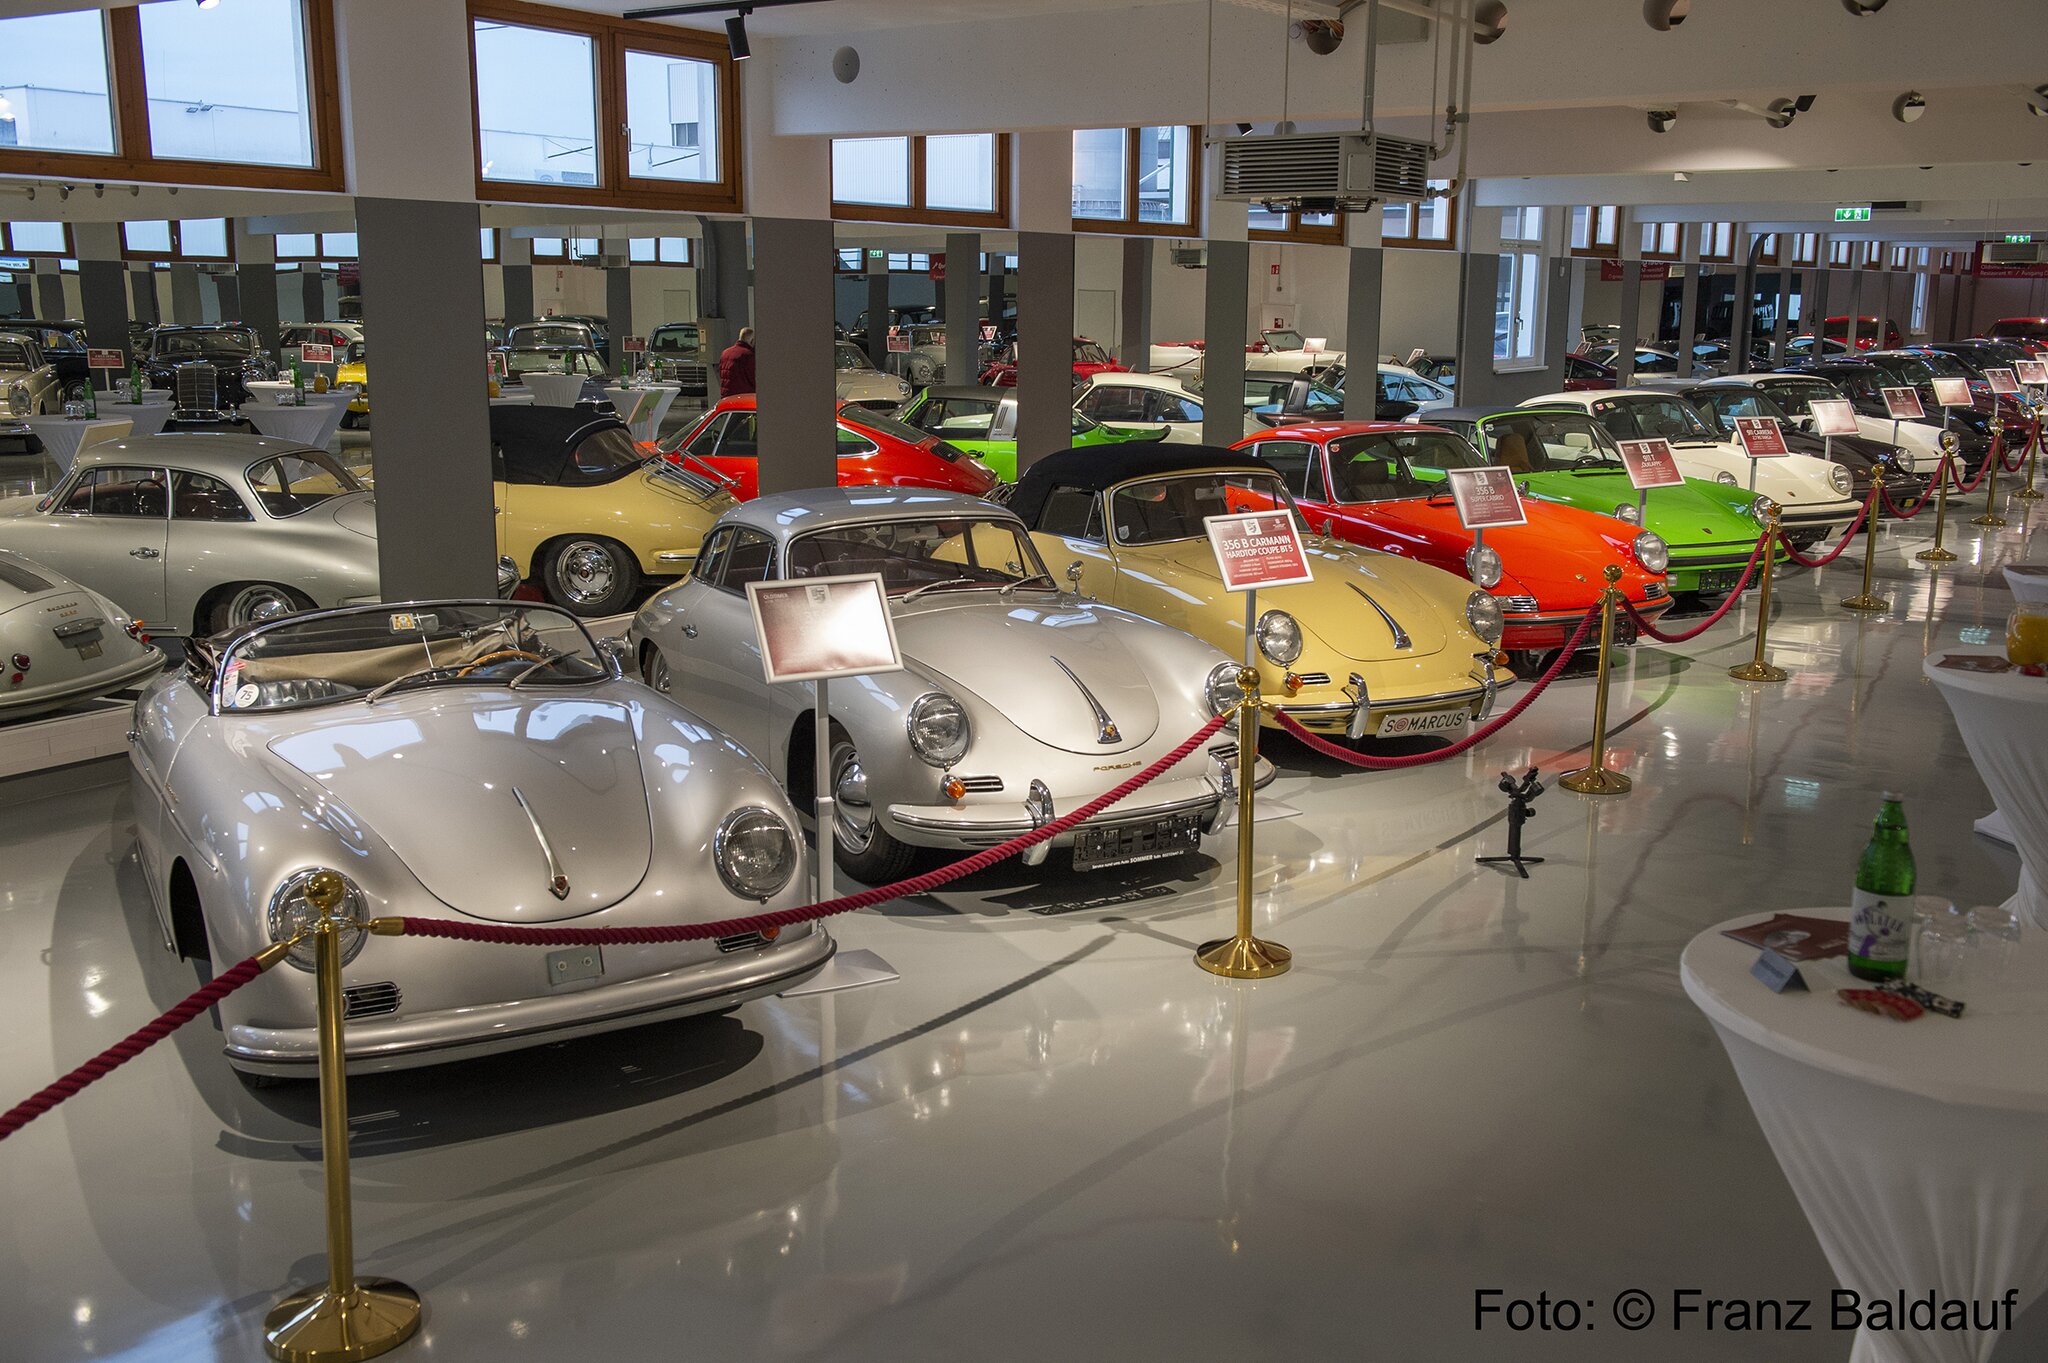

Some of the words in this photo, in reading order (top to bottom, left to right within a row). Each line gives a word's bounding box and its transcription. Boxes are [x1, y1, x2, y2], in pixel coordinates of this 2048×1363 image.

[1642, 454, 1651, 462] 911
[1475, 486, 1489, 495] 356
[1488, 486, 1495, 494] B
[1486, 494, 1504, 502] CABRIO
[1222, 539, 1241, 551] 356
[1241, 538, 1249, 548] B
[1249, 536, 1291, 547] CARMANN
[1225, 549, 1257, 558] HARDTOP
[1257, 546, 1280, 555] COUPE
[1288, 544, 1294, 552] 5
[240, 690, 253, 701] 75
[1384, 719, 1396, 733] S
[1407, 712, 1464, 731] MARCUS
[1093, 761, 1142, 772] PORSCHE
[1130, 855, 1153, 863] SOMMER
